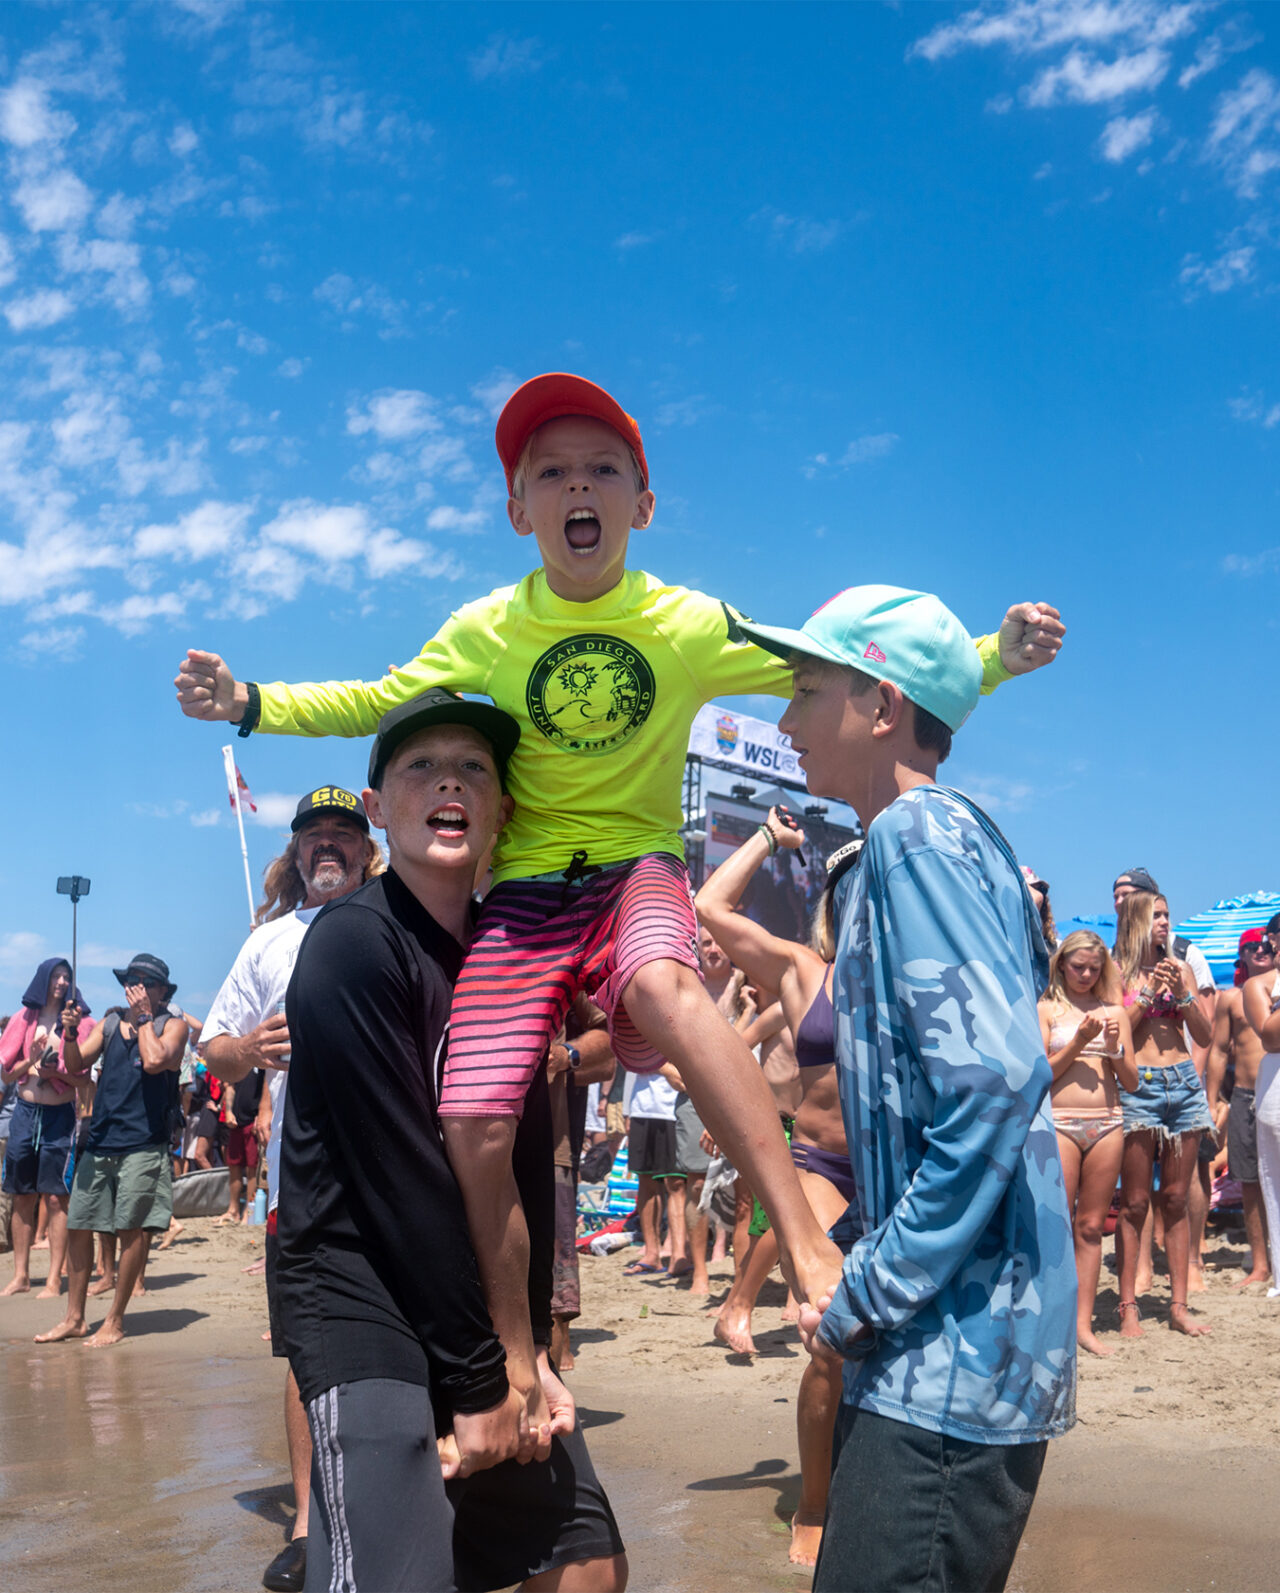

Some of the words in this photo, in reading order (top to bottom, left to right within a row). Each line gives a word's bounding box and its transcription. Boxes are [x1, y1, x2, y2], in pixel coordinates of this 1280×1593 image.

[547, 645, 577, 668] SAN
[586, 641, 636, 665] DIEGO
[744, 742, 781, 771] WSL
